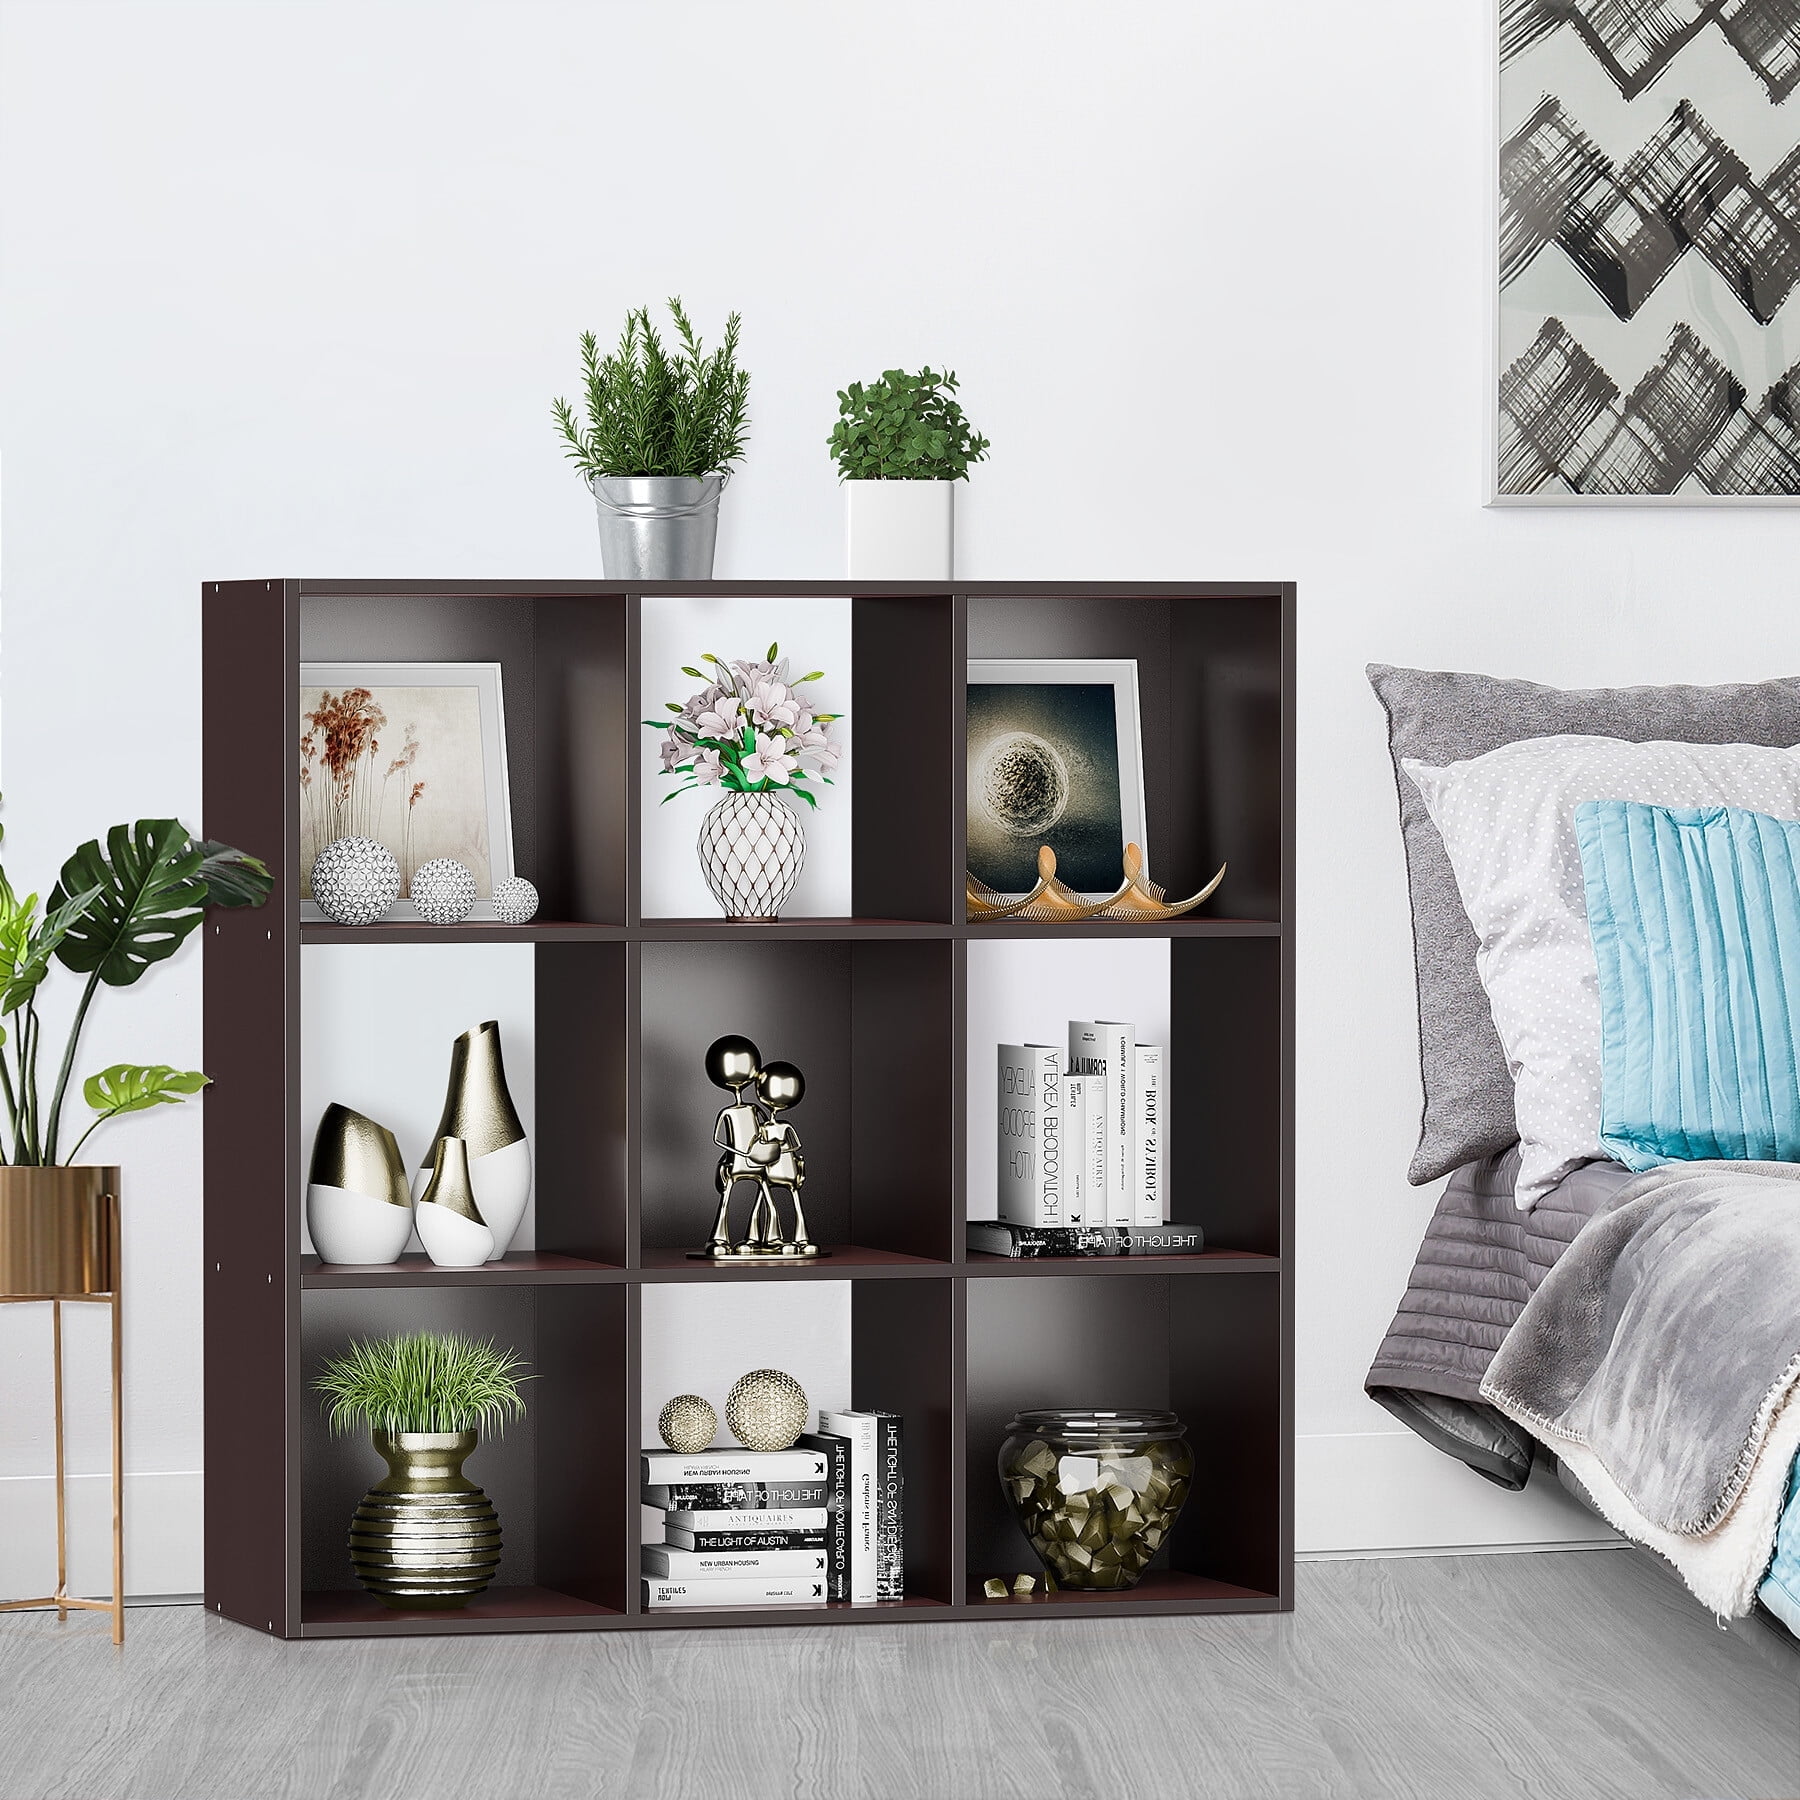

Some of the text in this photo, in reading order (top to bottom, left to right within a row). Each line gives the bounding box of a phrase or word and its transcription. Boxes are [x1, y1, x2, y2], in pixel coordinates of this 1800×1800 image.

[729, 1514, 794, 1523] ANTIQUAIRES
[699, 1536, 788, 1547] THE LIGHT OF AUSTIN
